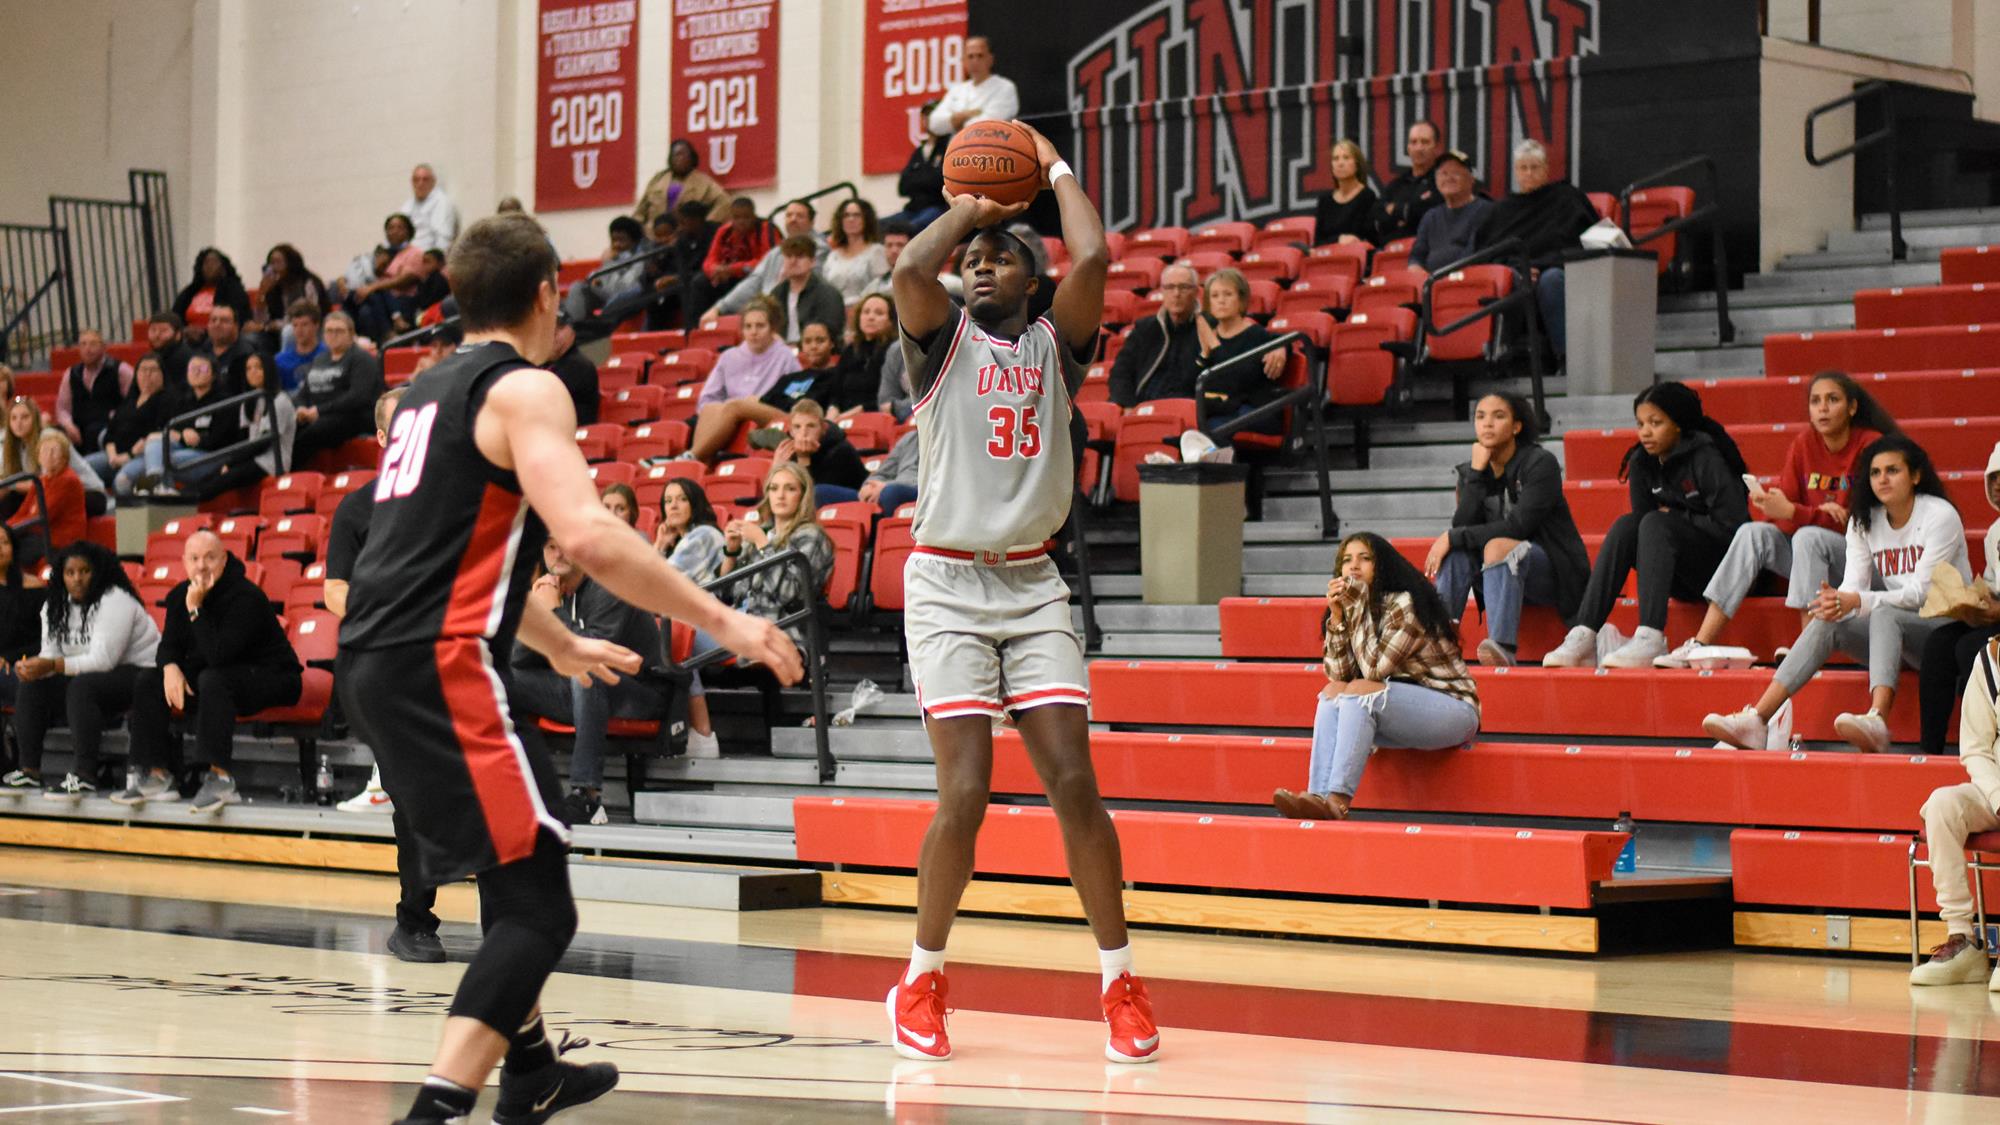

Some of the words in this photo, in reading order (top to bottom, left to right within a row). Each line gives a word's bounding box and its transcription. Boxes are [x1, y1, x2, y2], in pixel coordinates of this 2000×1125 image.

[883, 35, 963, 98] 2018
[550, 91, 623, 148] 2020
[687, 74, 759, 133] 2021
[1068, 0, 1598, 236] UNION
[571, 149, 599, 189] U
[708, 134, 738, 175] U
[952, 154, 1016, 175] Wilson
[373, 400, 439, 503] 20
[986, 404, 1043, 460] 35
[983, 549, 1000, 567] U
[1873, 544, 1925, 577] NIO
[194, 972, 454, 999] COURT
